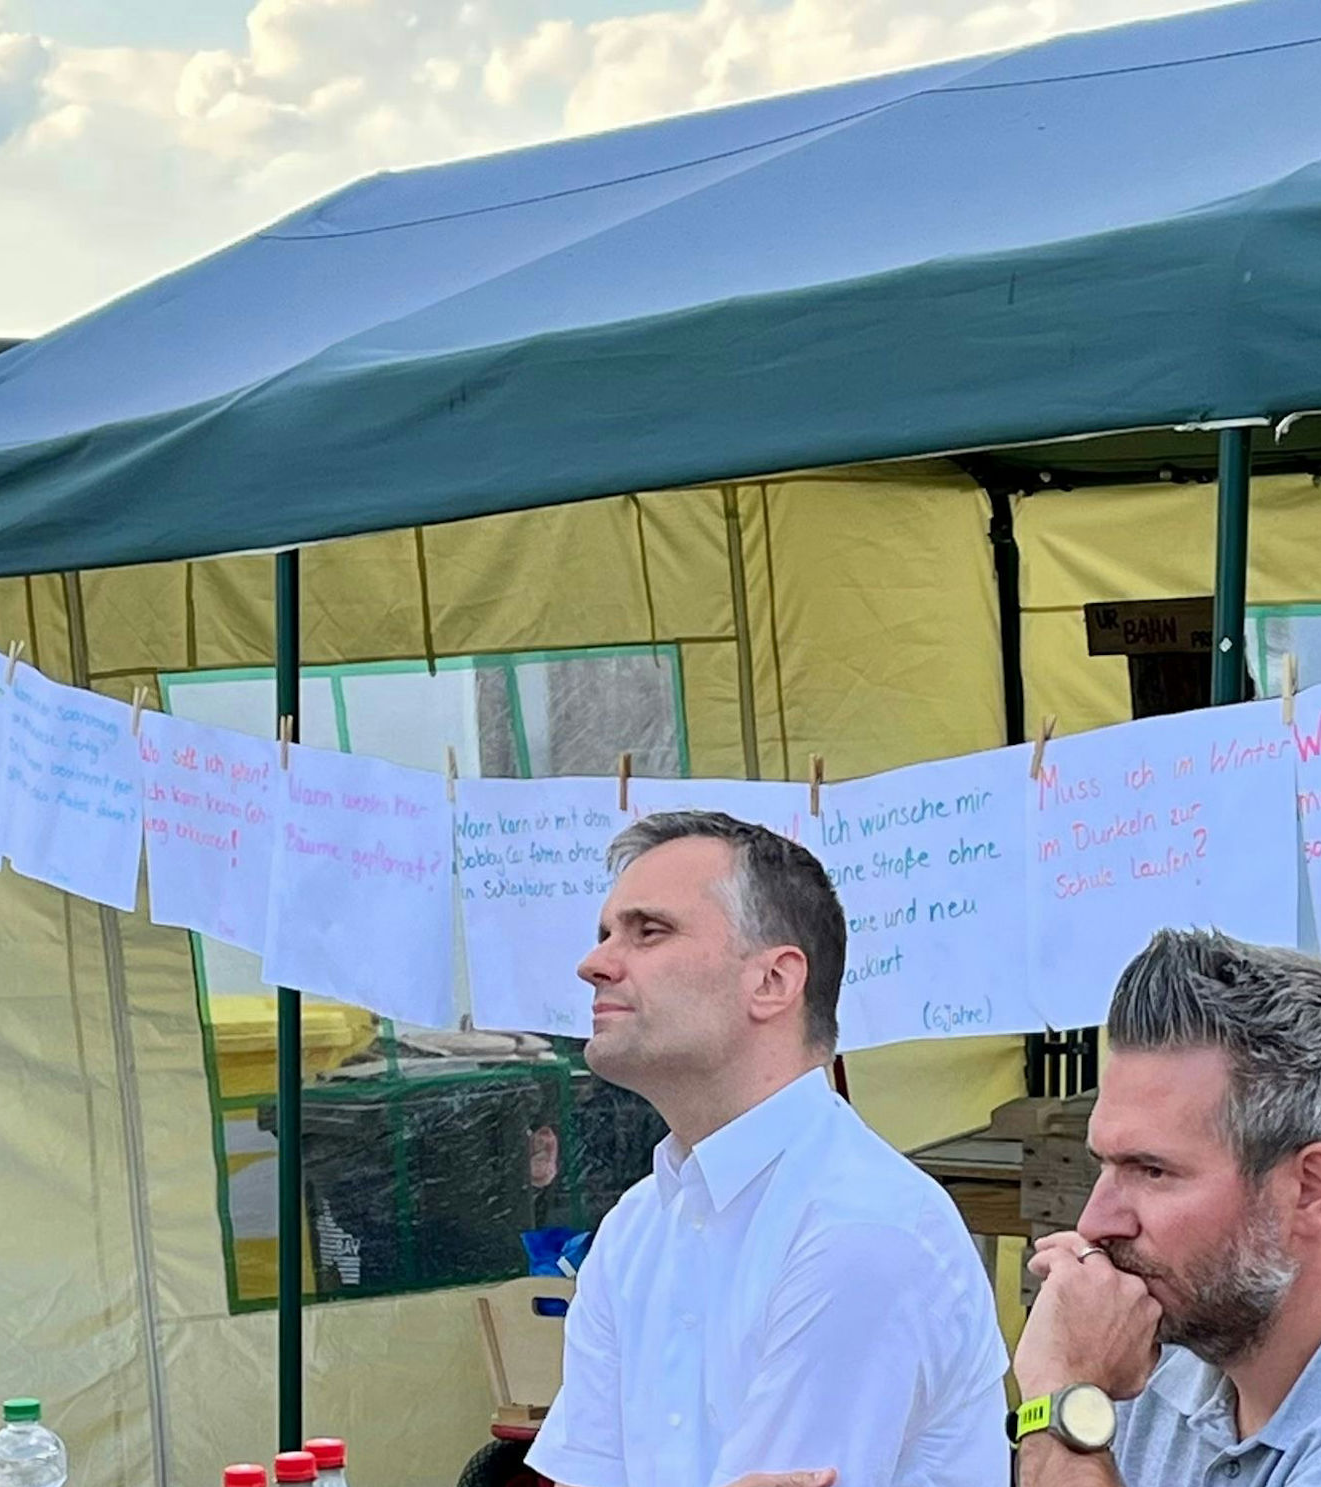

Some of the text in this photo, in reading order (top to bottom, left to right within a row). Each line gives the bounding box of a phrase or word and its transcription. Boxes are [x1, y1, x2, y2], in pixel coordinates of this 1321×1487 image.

[1123, 617, 1178, 645] BAHN
[205, 754, 224, 776] ich
[1039, 736, 1291, 810] Muss ich im Winter
[289, 773, 333, 806] Wann
[821, 809, 850, 847] Ich
[859, 798, 950, 837] wünsche
[956, 787, 993, 815] mir
[1038, 802, 1201, 862] im Dunkeln zur
[285, 823, 343, 861] Bäume
[568, 841, 604, 862] ohne
[873, 847, 929, 879] Straße
[948, 837, 1002, 866] ohne
[563, 880, 578, 895] zu
[1055, 866, 1116, 899] Schule
[884, 898, 917, 929] und
[929, 898, 979, 922] neu
[842, 945, 904, 987] ackiert
